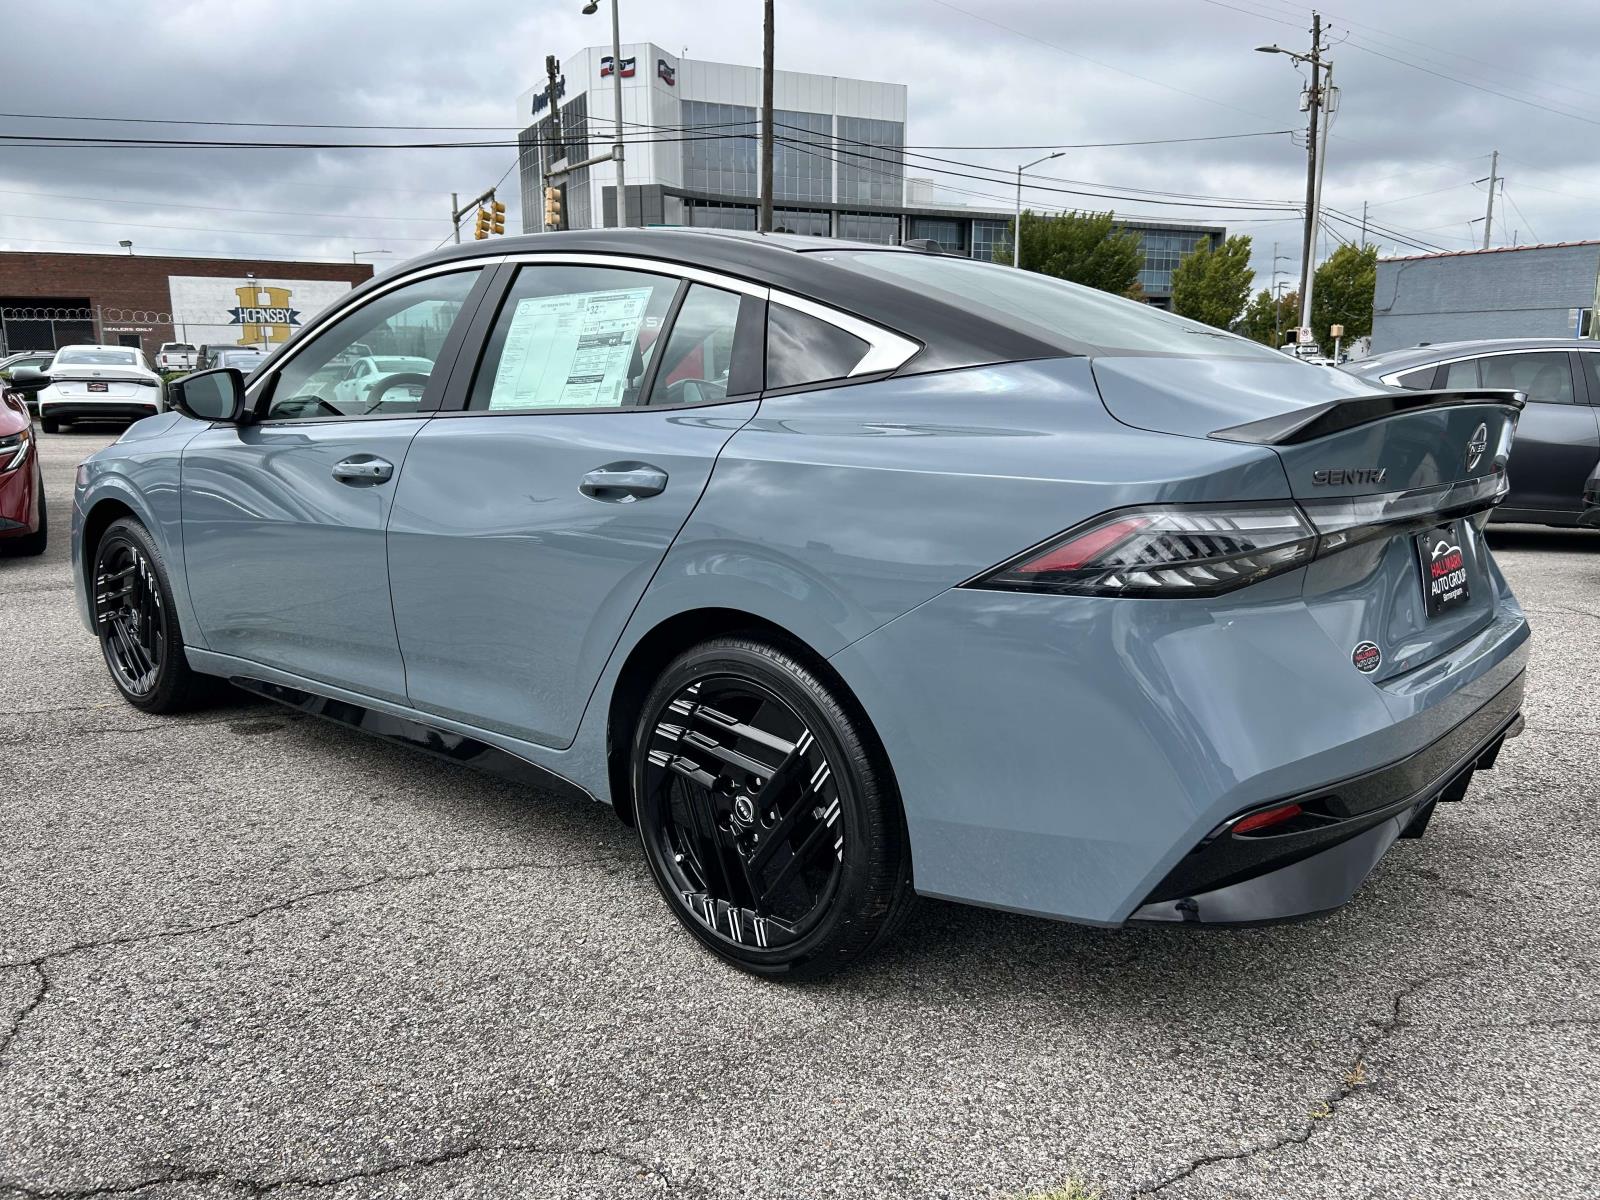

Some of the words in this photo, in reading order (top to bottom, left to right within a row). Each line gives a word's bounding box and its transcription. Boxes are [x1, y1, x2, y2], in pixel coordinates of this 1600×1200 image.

[239, 308, 291, 323] HORNSBY
[1430, 552, 1463, 577] HALLMARK
[1431, 576, 1449, 596] AUTO
[1448, 567, 1466, 588] GROUP
[1443, 587, 1463, 602] Birmingham
